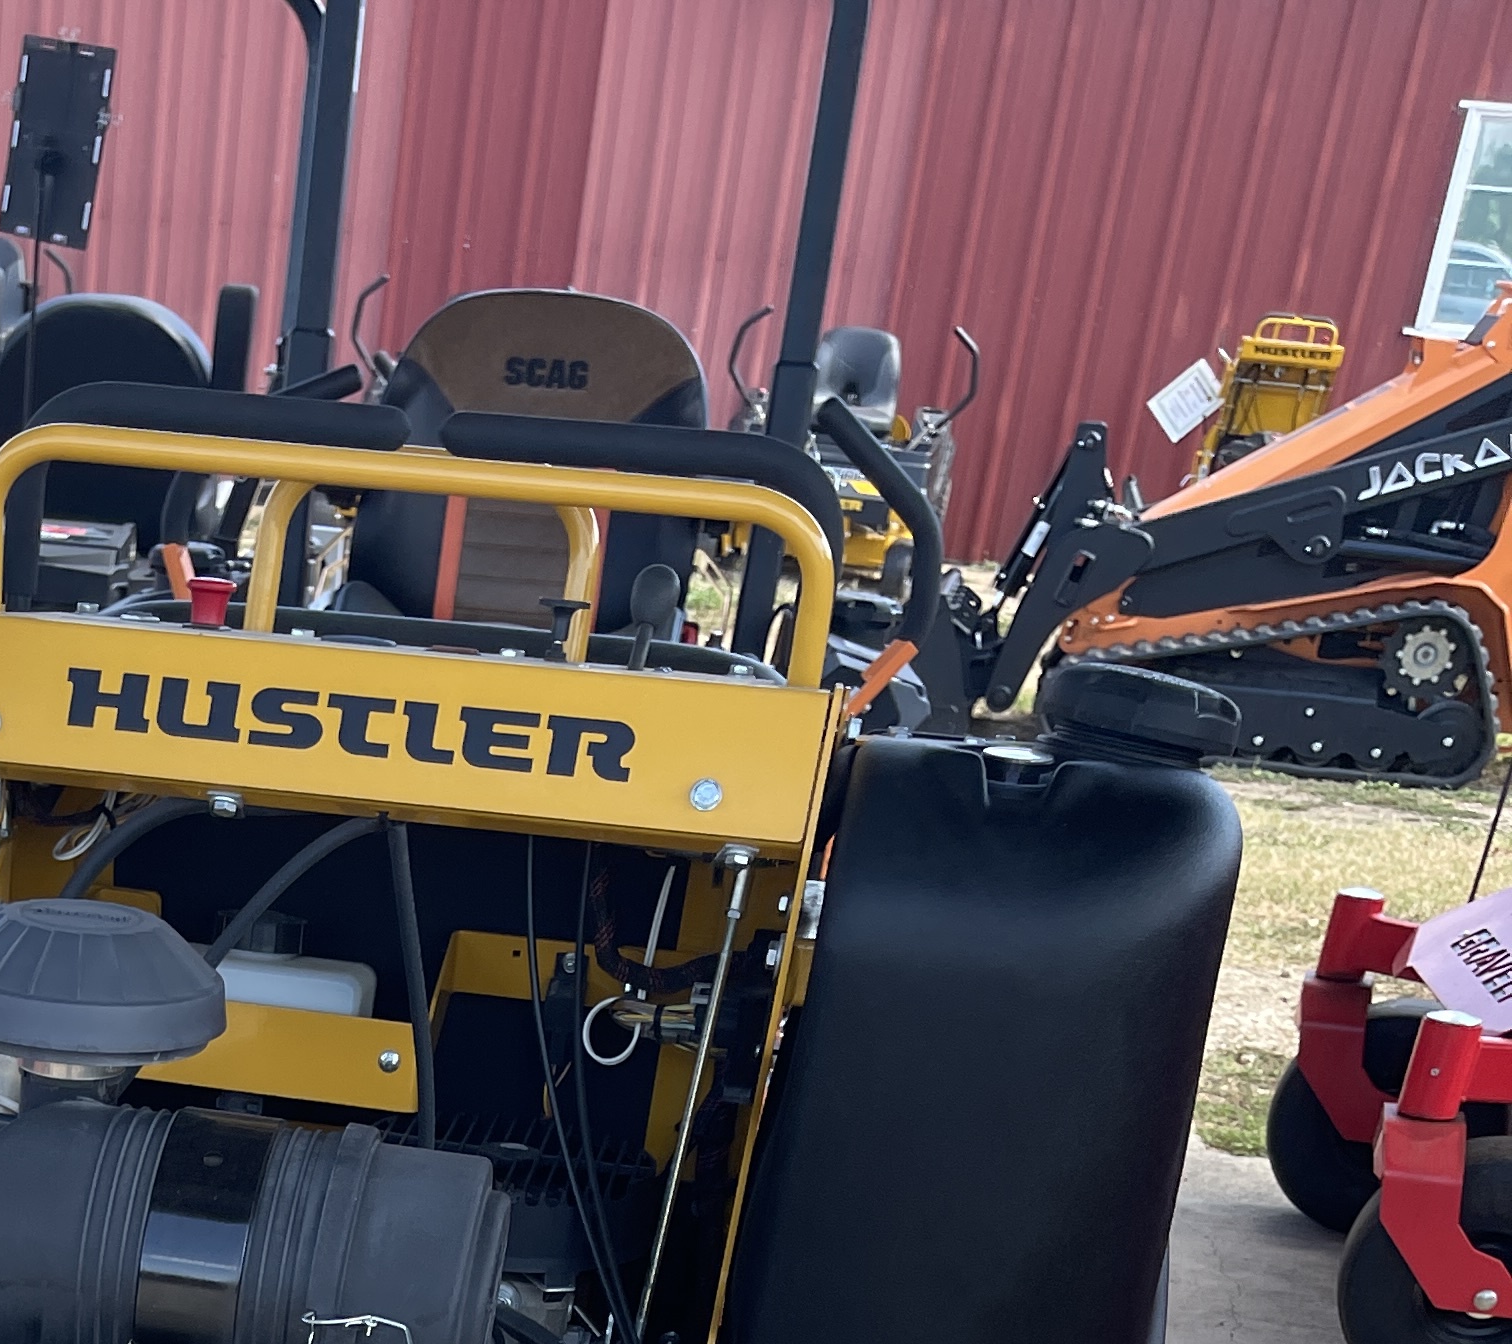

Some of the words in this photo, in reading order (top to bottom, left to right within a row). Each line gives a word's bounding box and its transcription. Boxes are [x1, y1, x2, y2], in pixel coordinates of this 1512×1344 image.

[503, 356, 590, 390] SCAG
[1254, 345, 1332, 361] HUSTLER
[1357, 434, 1512, 501] JACKA
[67, 667, 636, 783] HUSTLER
